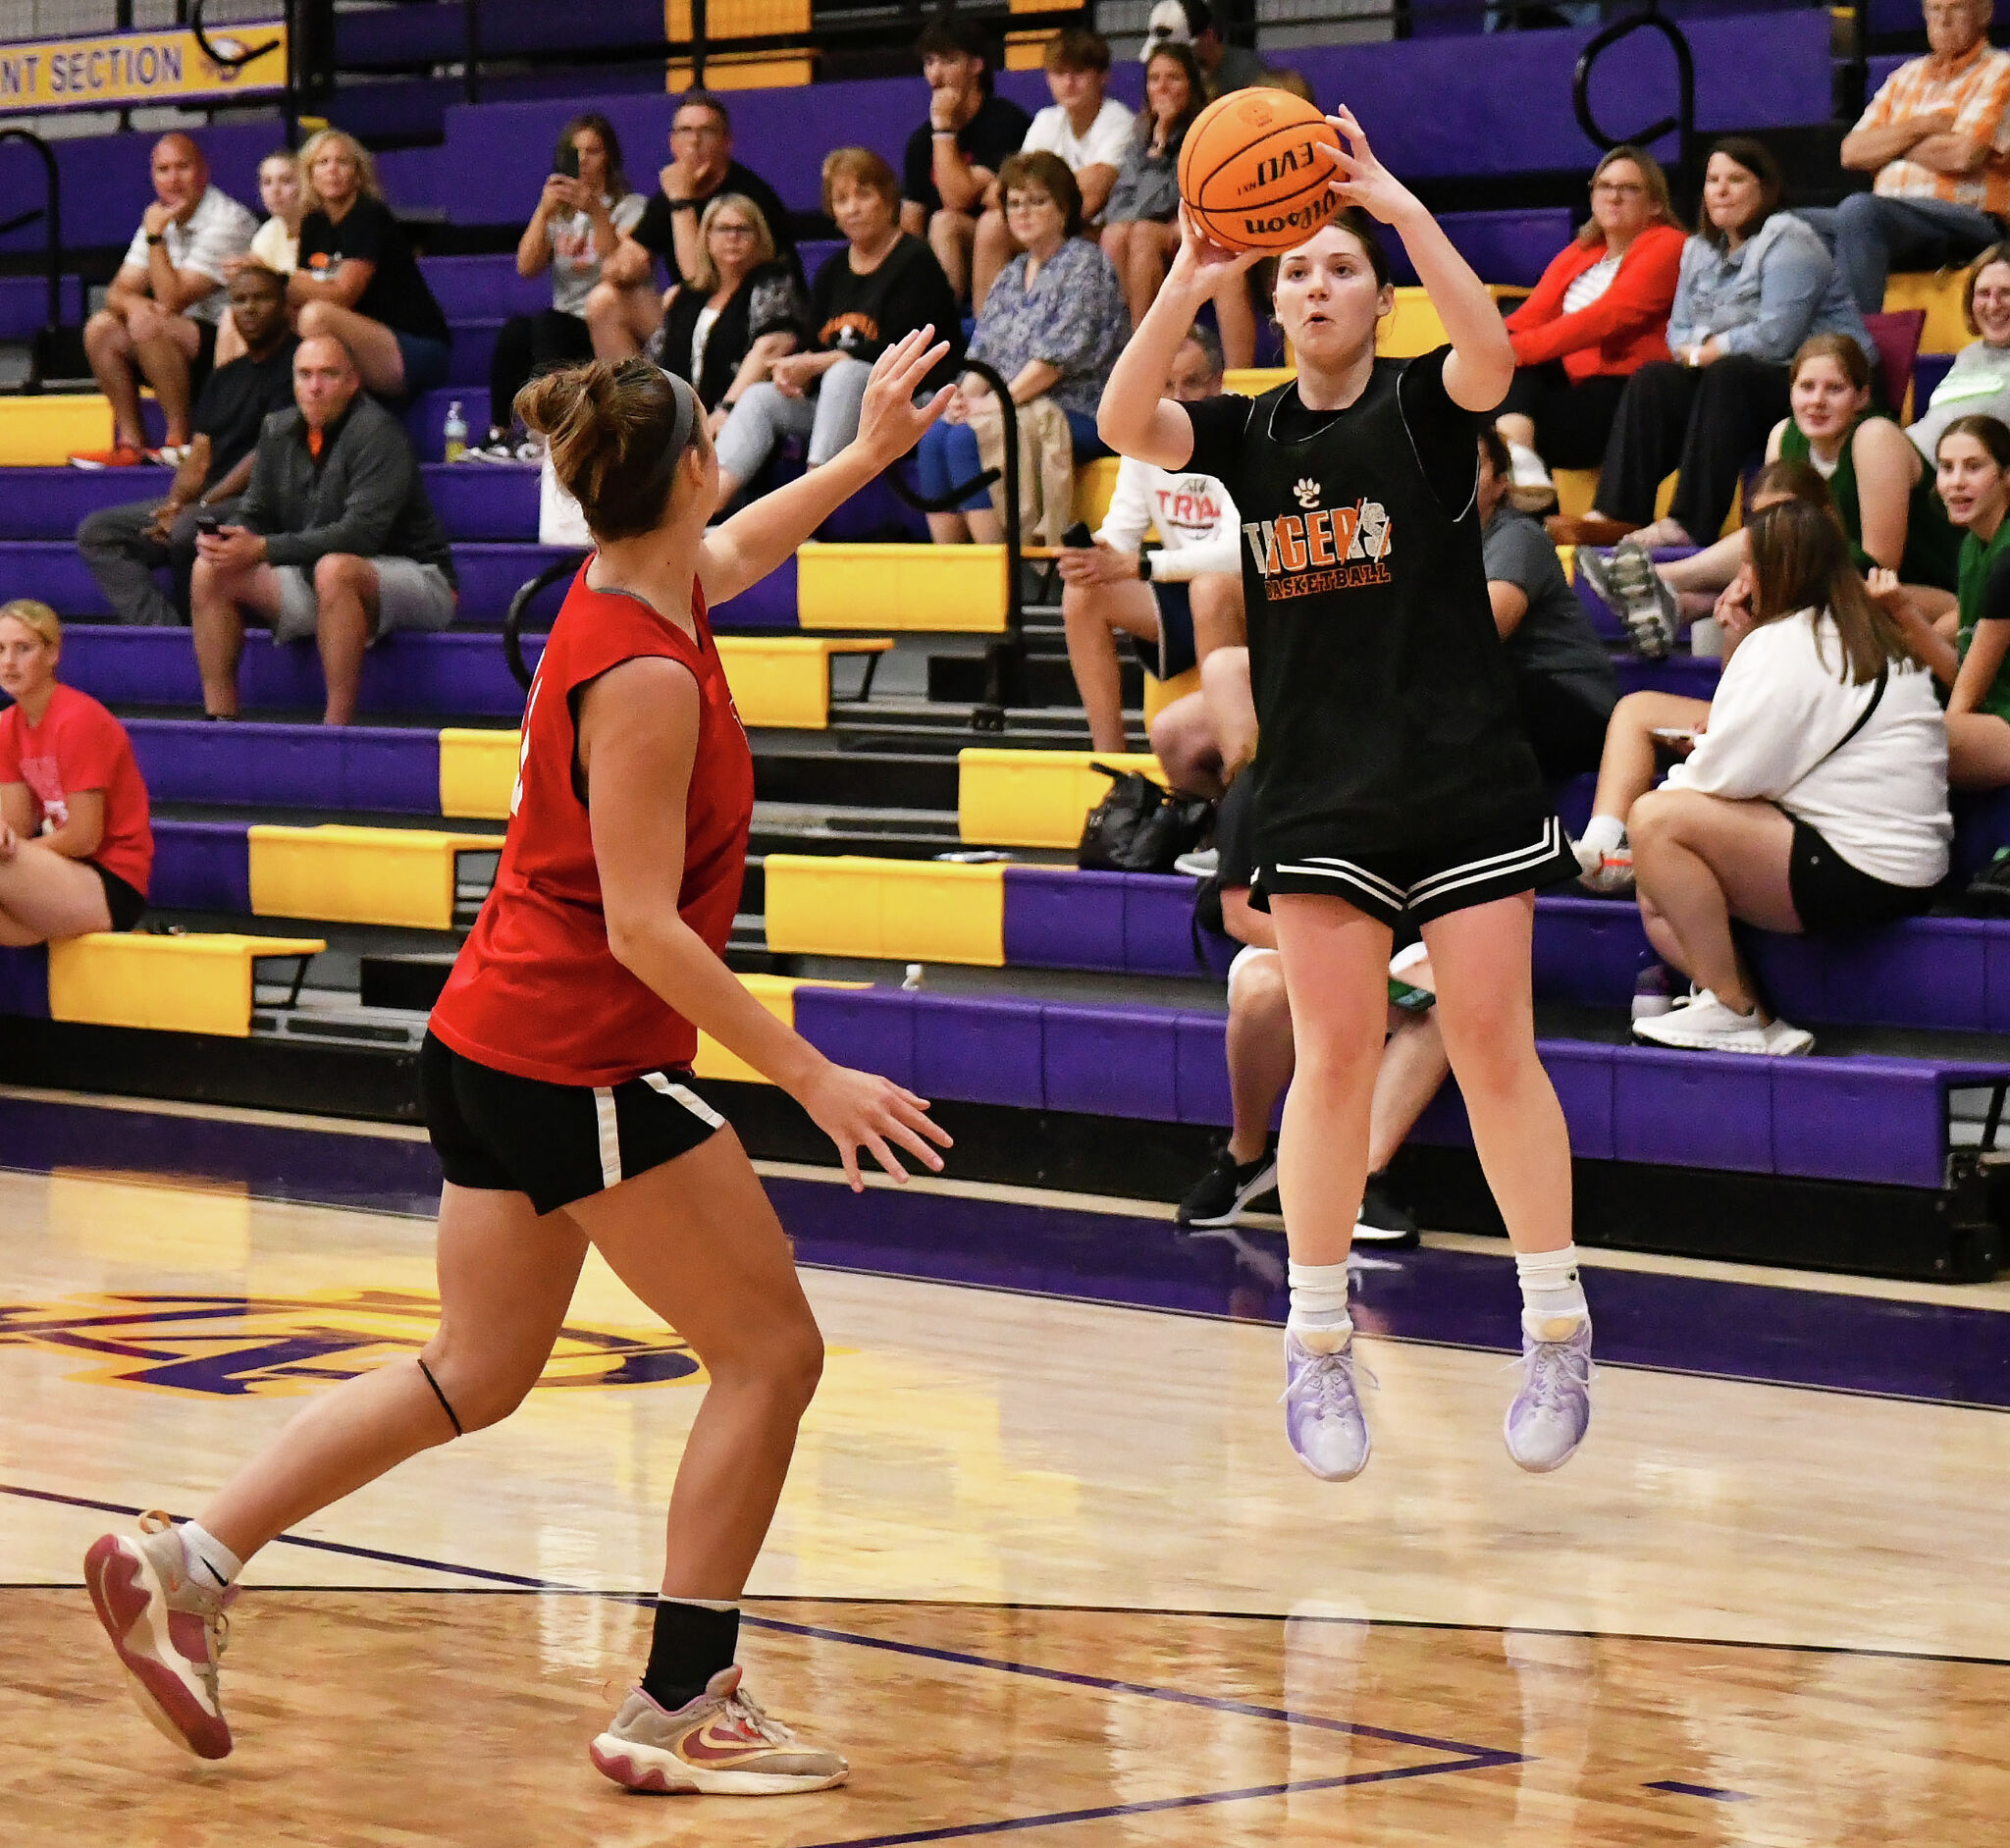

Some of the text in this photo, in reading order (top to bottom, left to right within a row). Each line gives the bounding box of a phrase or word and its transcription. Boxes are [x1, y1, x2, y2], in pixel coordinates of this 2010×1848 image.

[51, 46, 184, 93] SECTION
[1257, 141, 1314, 186] EVO
[1242, 498, 1393, 579] TIGERS
[1263, 562, 1392, 601] BASKETBALL
